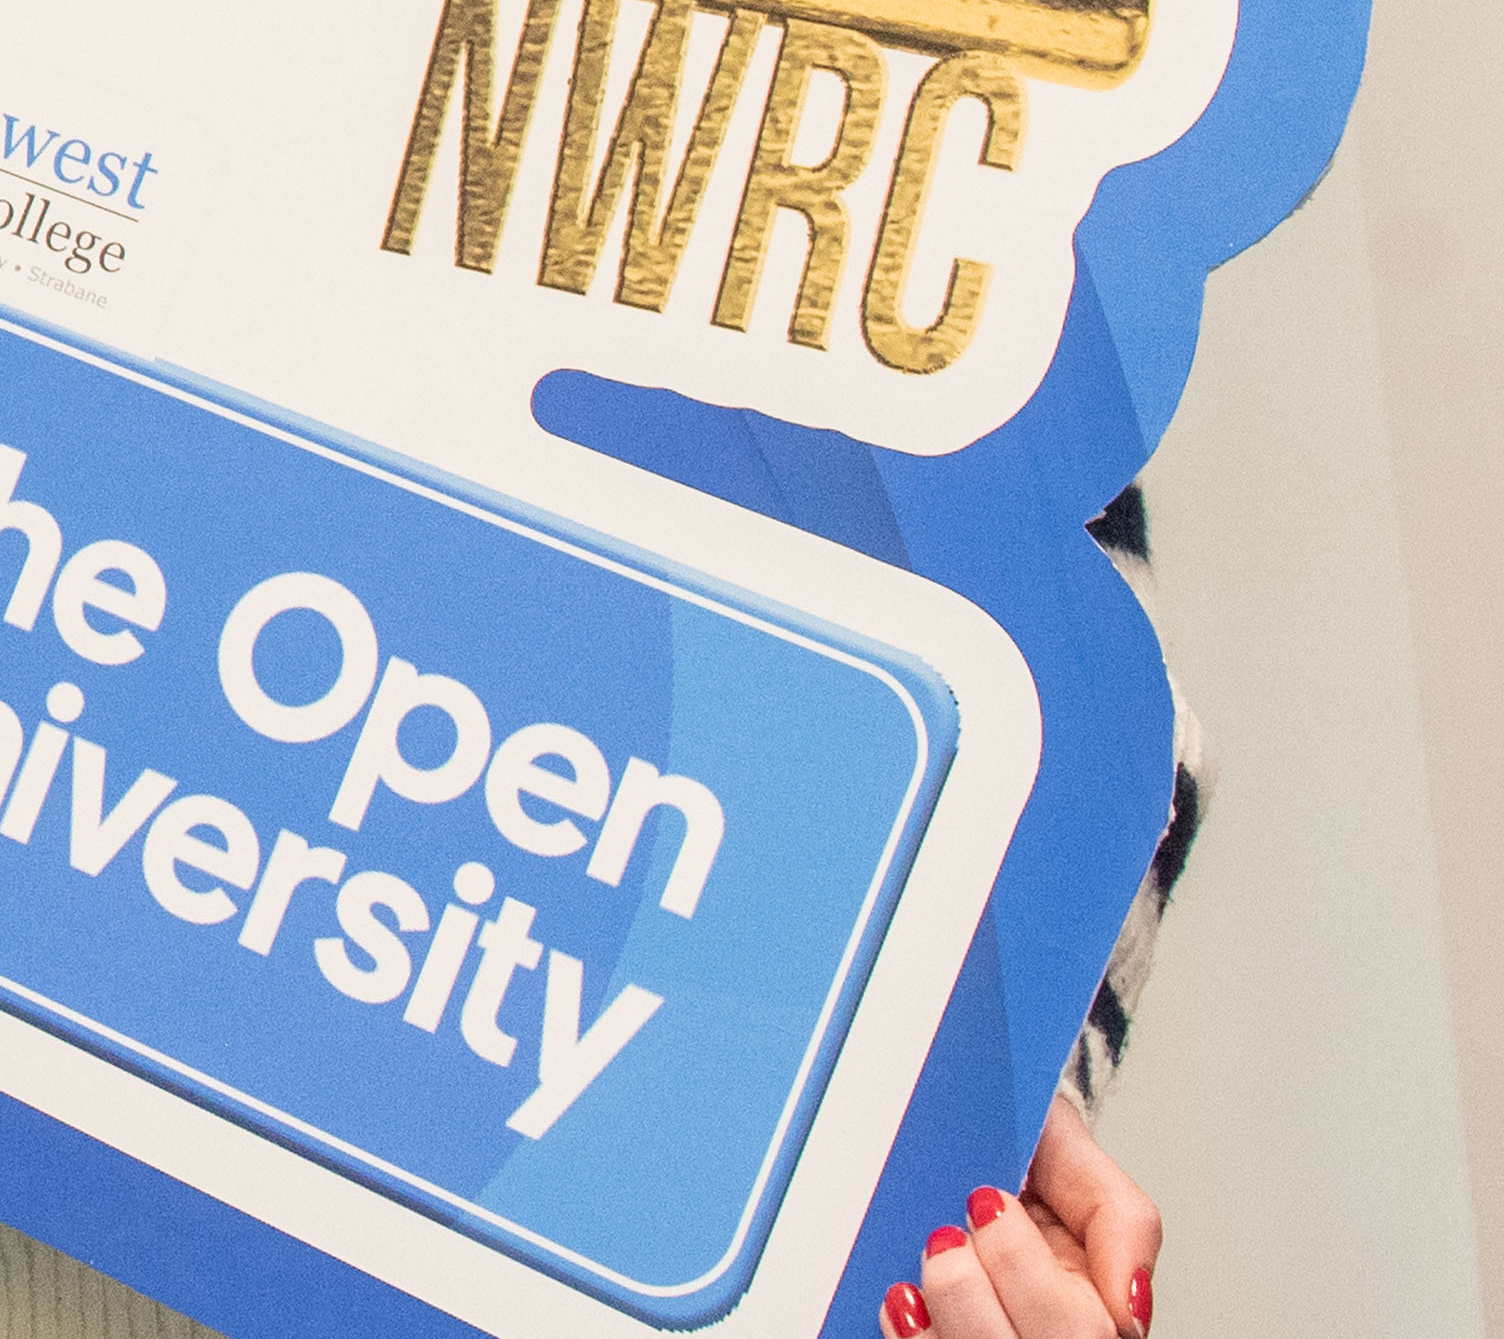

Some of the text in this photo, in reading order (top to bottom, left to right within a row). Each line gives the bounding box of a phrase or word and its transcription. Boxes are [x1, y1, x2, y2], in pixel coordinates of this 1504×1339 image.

[2, 113, 160, 211] west
[26, 265, 109, 310] Strabane
[218, 571, 727, 919] Open
